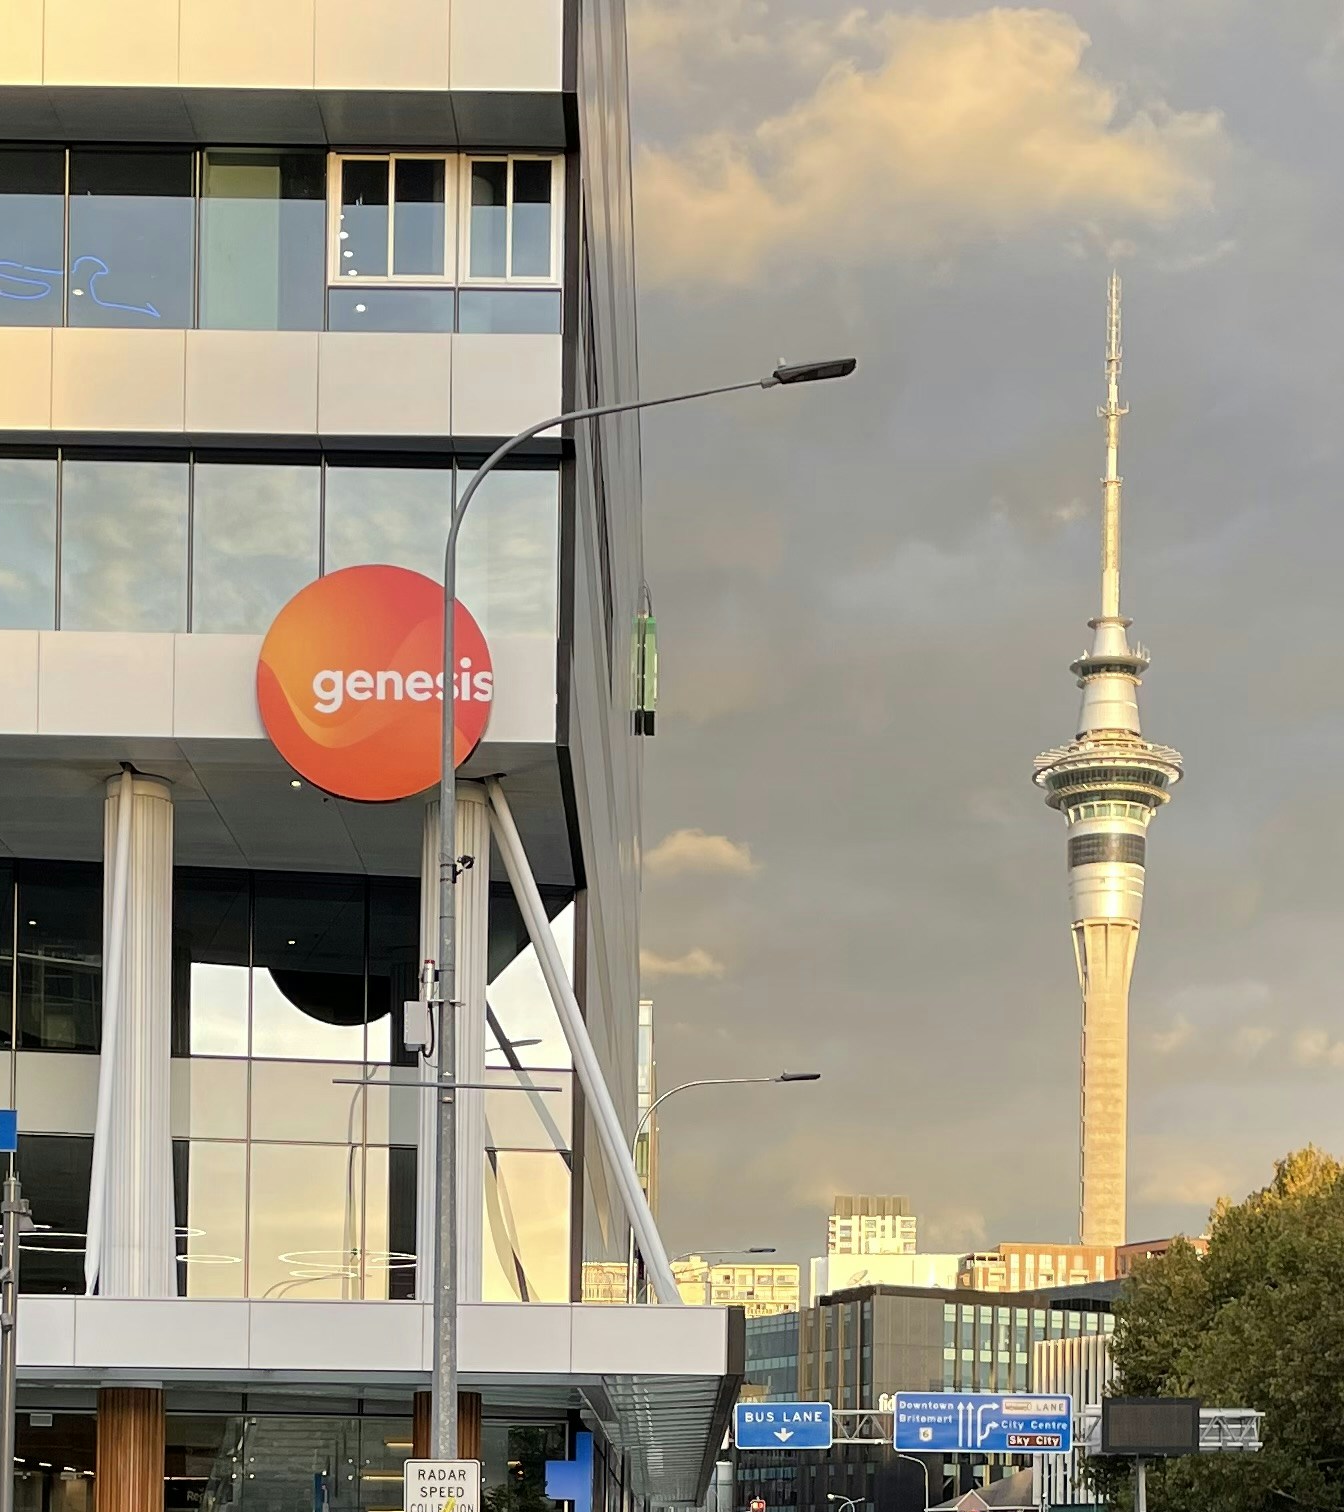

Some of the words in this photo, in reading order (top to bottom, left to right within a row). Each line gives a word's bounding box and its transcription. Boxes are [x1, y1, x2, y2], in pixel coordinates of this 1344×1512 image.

[312, 656, 493, 714] genesis
[899, 1400, 954, 1410] Downtown
[1036, 1402, 1064, 1412] LANE
[744, 1411, 775, 1423] BUS
[783, 1411, 823, 1423] LANE
[1001, 1420, 1025, 1431] City
[1030, 1420, 1068, 1430] Centre
[1009, 1435, 1030, 1446] Sky
[1036, 1435, 1060, 1446] City
[417, 1469, 467, 1481] RADAR
[420, 1486, 465, 1498] SPEED
